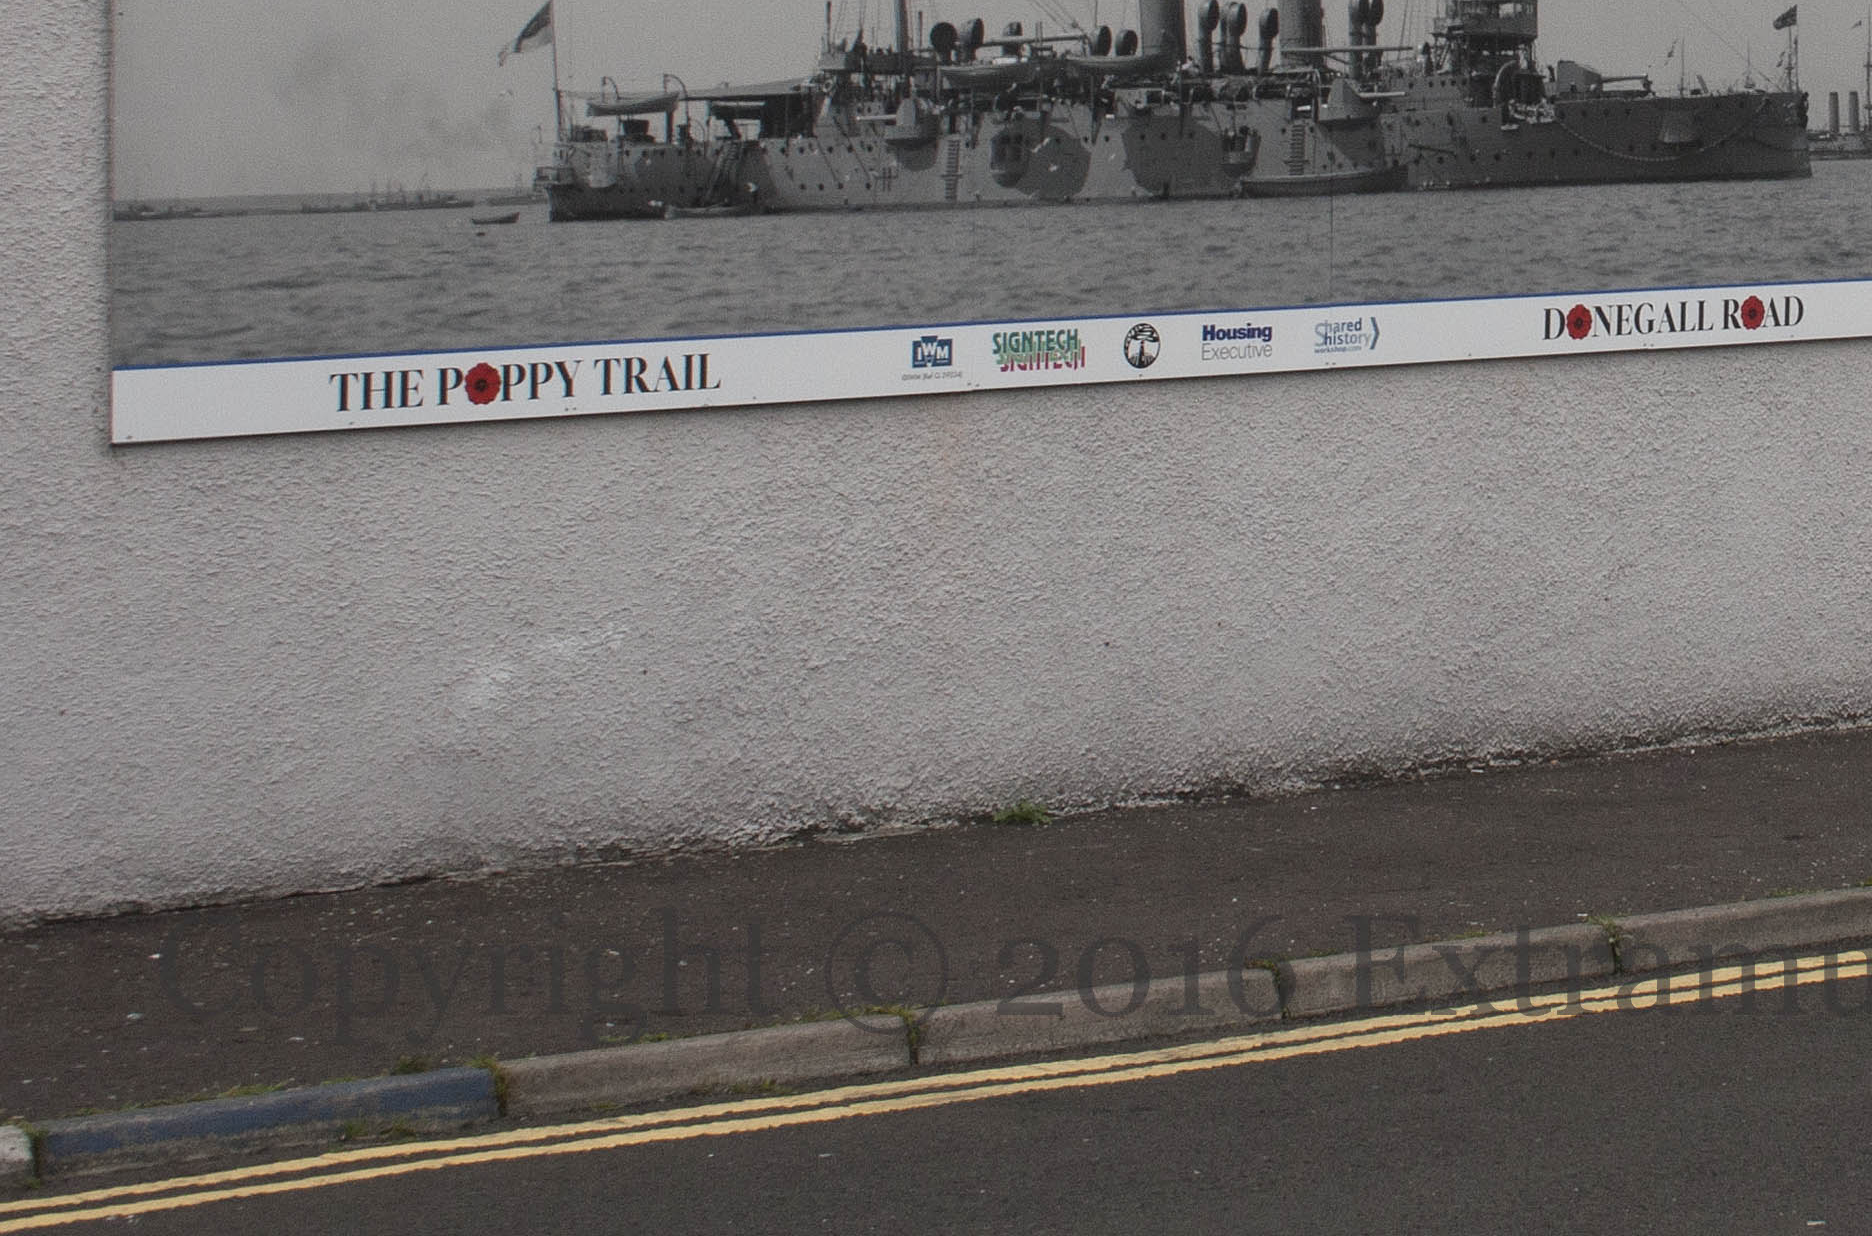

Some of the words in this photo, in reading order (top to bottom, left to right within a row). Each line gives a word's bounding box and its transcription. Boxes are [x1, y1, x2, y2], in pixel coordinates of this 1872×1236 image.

[992, 328, 1079, 355] SIGNTECH
[1202, 322, 1273, 343] Housing
[1315, 317, 1363, 346] Shared
[1324, 329, 1371, 347] history
[916, 342, 949, 361] IWM
[1201, 342, 1273, 361] Executive
[328, 368, 424, 413] THE
[594, 352, 722, 397] TRAIL
